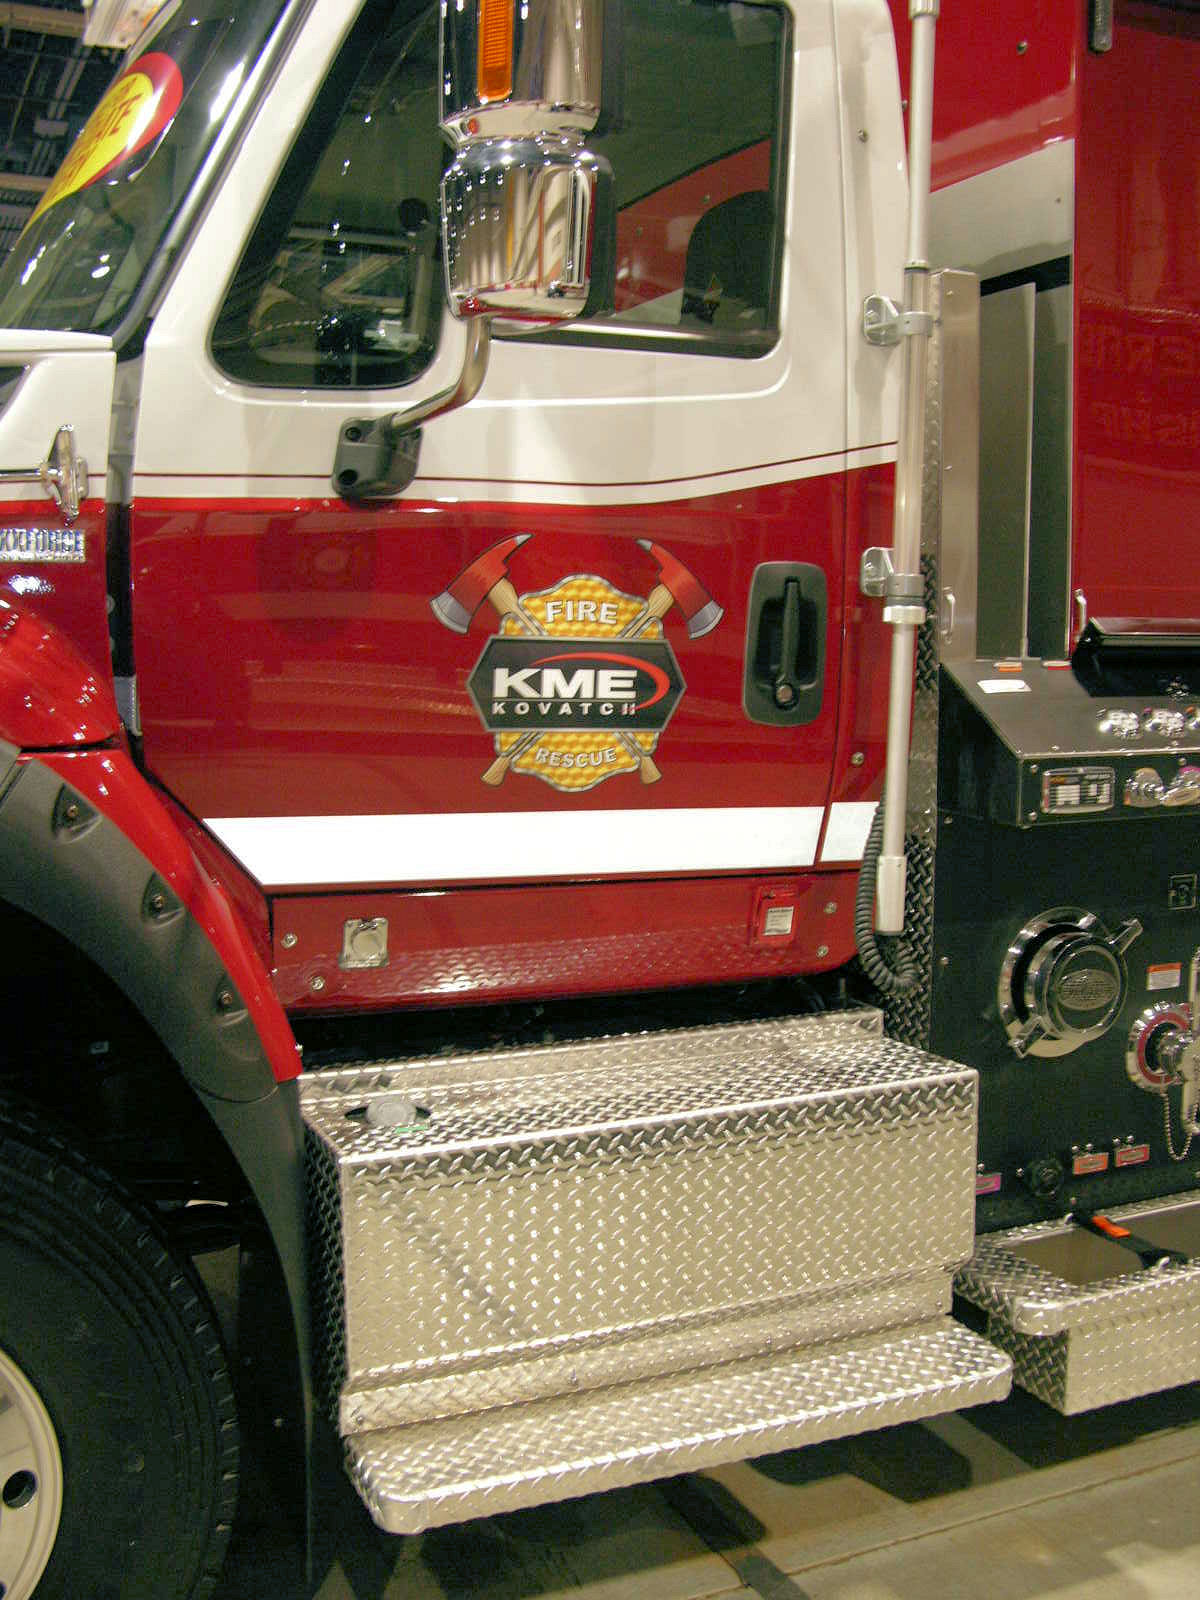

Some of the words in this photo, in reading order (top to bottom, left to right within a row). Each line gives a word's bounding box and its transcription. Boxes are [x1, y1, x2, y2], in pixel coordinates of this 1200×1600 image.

[545, 600, 618, 625] FIRE
[493, 667, 637, 699] KME
[491, 701, 637, 716] KOVATCH
[535, 747, 617, 768] RESCUE
